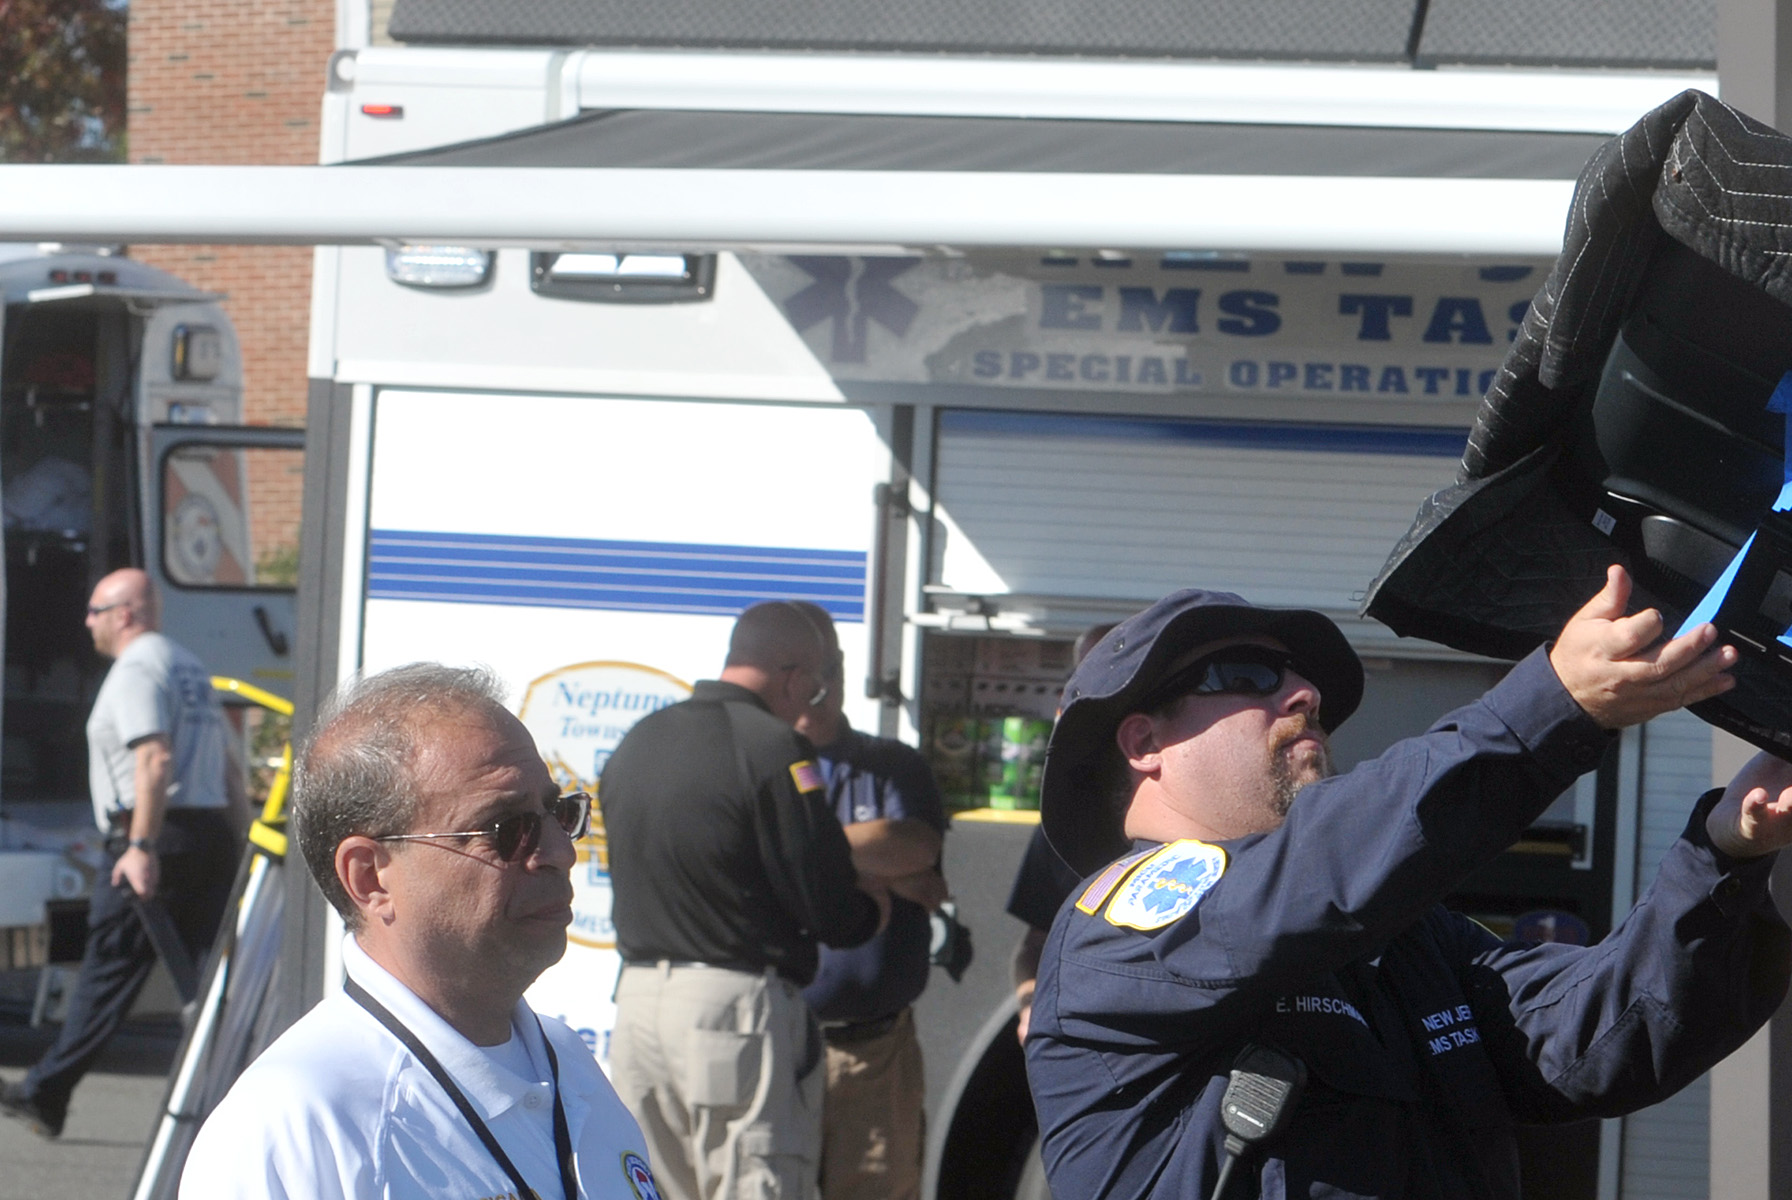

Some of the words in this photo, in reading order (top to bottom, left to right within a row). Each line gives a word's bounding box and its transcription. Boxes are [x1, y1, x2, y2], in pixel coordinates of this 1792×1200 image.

[1039, 284, 1282, 337] EMS
[972, 349, 1201, 386] SPECIAL
[1421, 1009, 1455, 1032] NEW
[1430, 1034, 1453, 1056] MS
